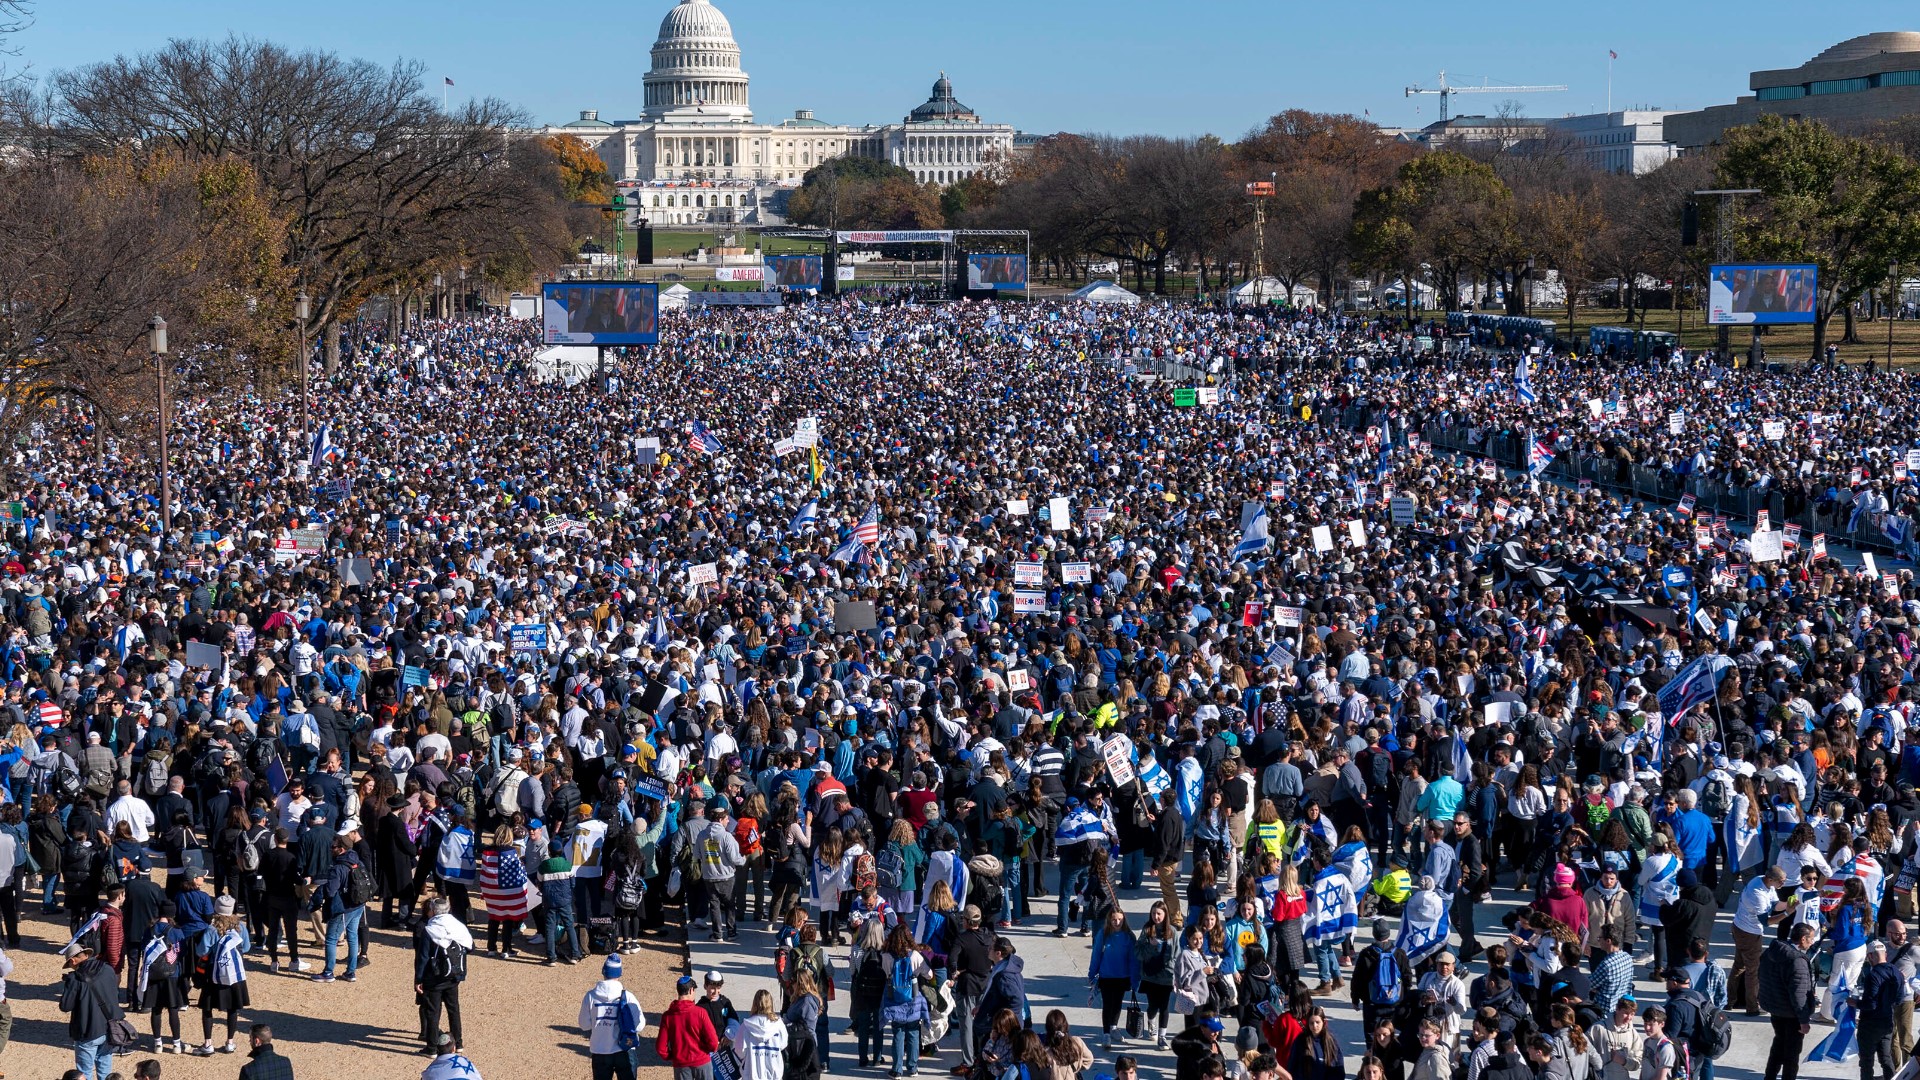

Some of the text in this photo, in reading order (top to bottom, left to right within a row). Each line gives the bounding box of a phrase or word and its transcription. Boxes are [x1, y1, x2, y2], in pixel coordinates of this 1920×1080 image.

[850, 232, 940, 242] AMERICANS MARCH FOR ISRAEL
[693, 575, 716, 583] HOME
[1015, 597, 1028, 605] MKE
[648, 778, 664, 788] STAND
[638, 781, 667, 796] WITH ISRAEL
[1896, 873, 1916, 885] NEVER
[1894, 880, 1913, 891] AGAIN
[721, 1053, 736, 1074] STAND
